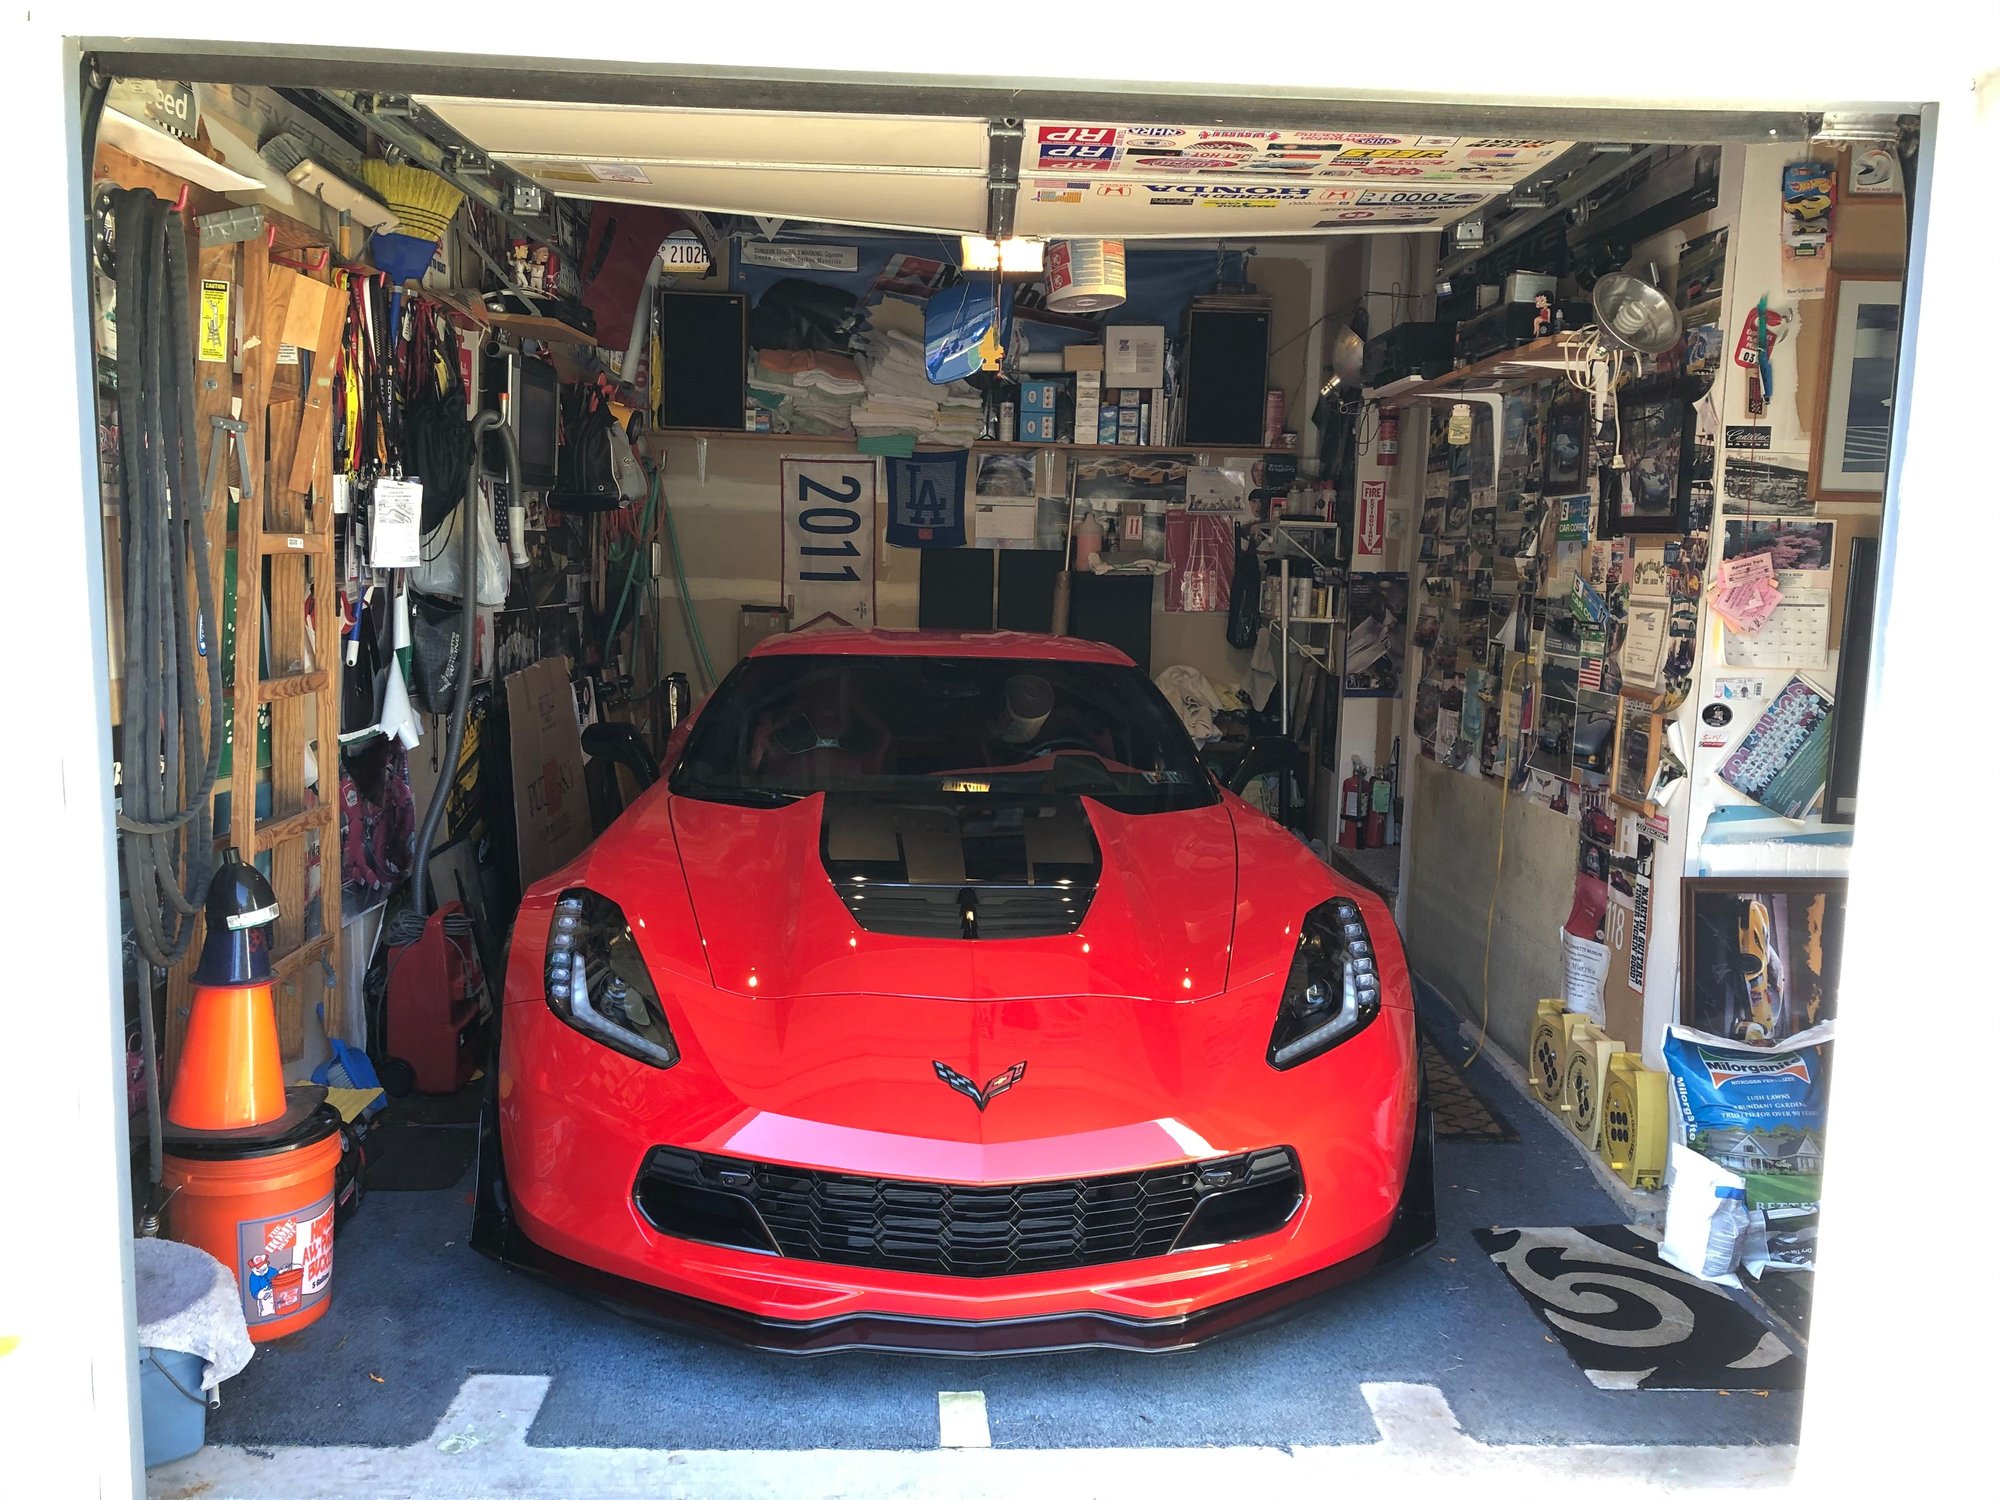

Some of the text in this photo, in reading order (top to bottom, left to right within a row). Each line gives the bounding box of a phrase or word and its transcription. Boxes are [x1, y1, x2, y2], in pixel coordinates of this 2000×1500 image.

[1047, 129, 1110, 140] RP
[1127, 128, 1178, 136] NHRA
[1047, 146, 1106, 158] RP
[1142, 184, 1315, 195] HONDA
[1390, 192, 1456, 202] 2000
[205, 282, 227, 290] CAUTION
[1742, 352, 1756, 364] 03
[1726, 429, 1770, 442] Cadillac
[906, 464, 946, 524] LA
[1364, 488, 1382, 498] FIRE
[798, 474, 862, 582] 2011
[1606, 900, 1624, 950] 118
[1635, 886, 1648, 986] MARTIN GUITARS
[1708, 1057, 1801, 1074] Milorganite
[1676, 1076, 1696, 1141] Milorgaite
[264, 1220, 296, 1254] HOME
